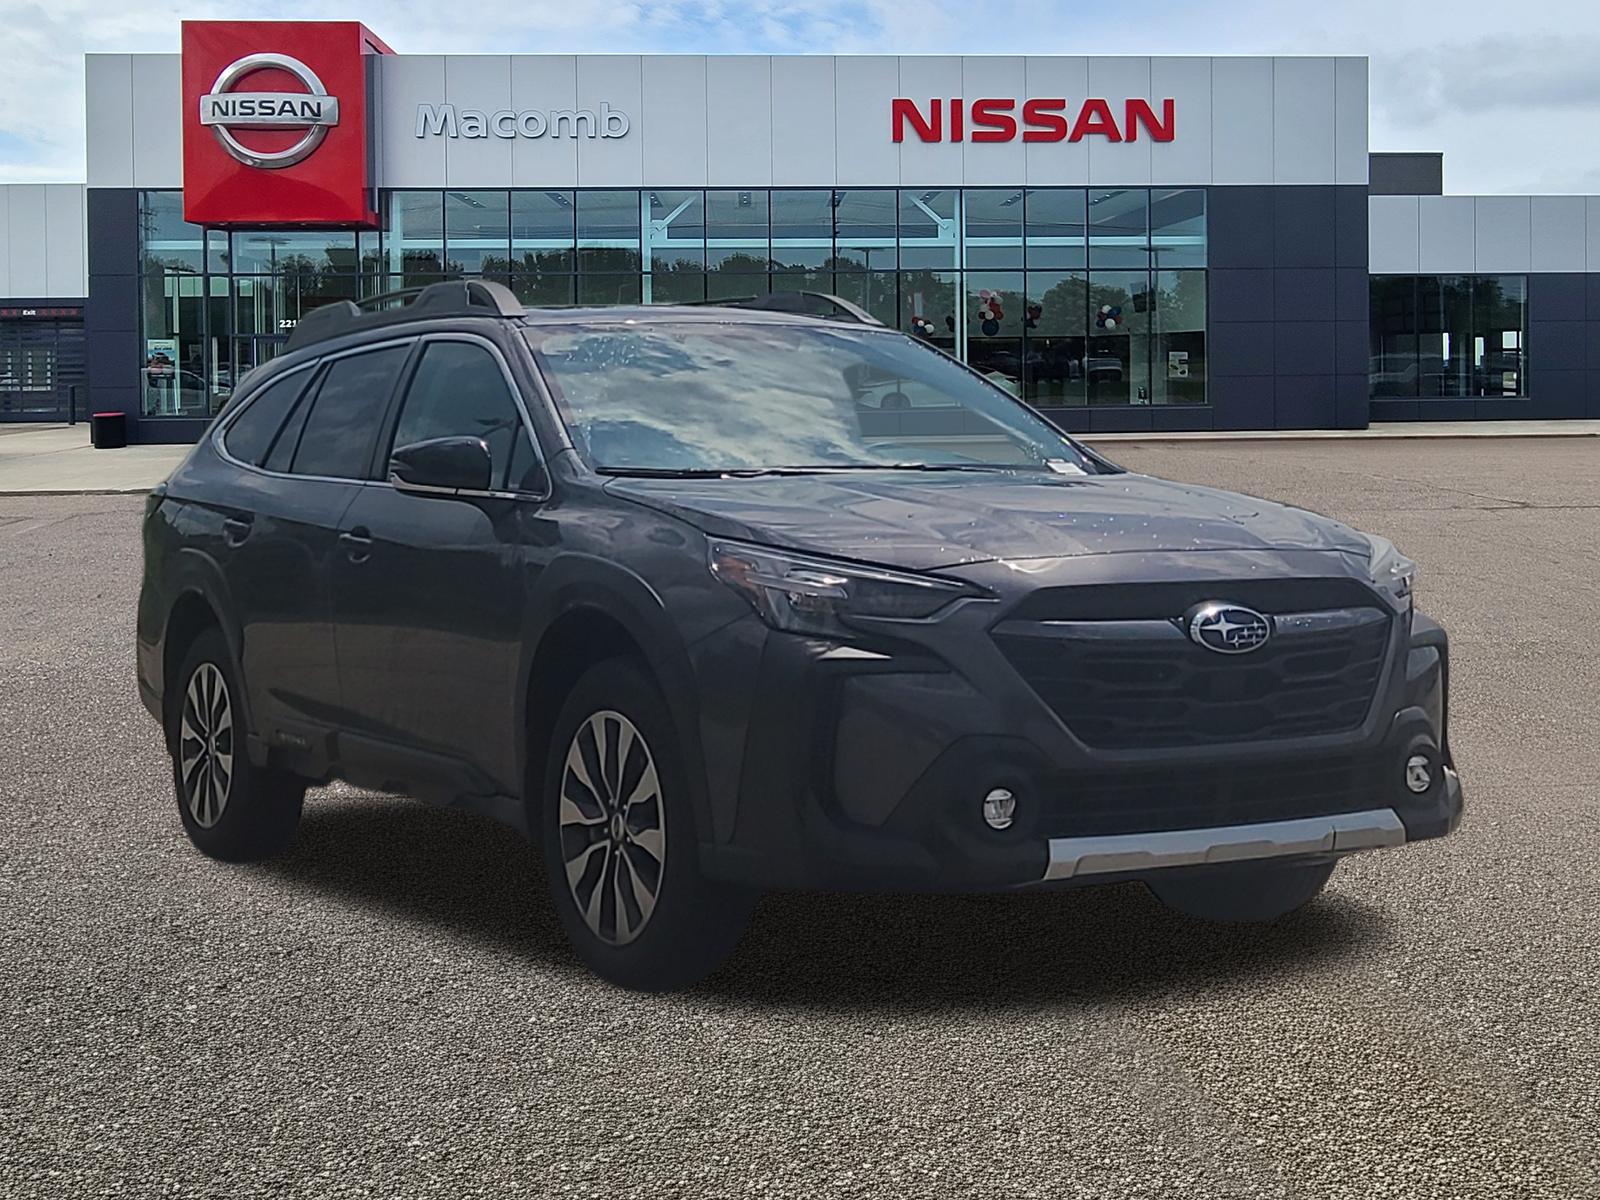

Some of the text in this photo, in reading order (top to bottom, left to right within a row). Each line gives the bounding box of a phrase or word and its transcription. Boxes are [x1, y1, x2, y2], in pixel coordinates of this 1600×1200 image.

[211, 100, 323, 118] NISSAN
[415, 102, 631, 139] Macomb
[892, 98, 1175, 143] NISSAN
